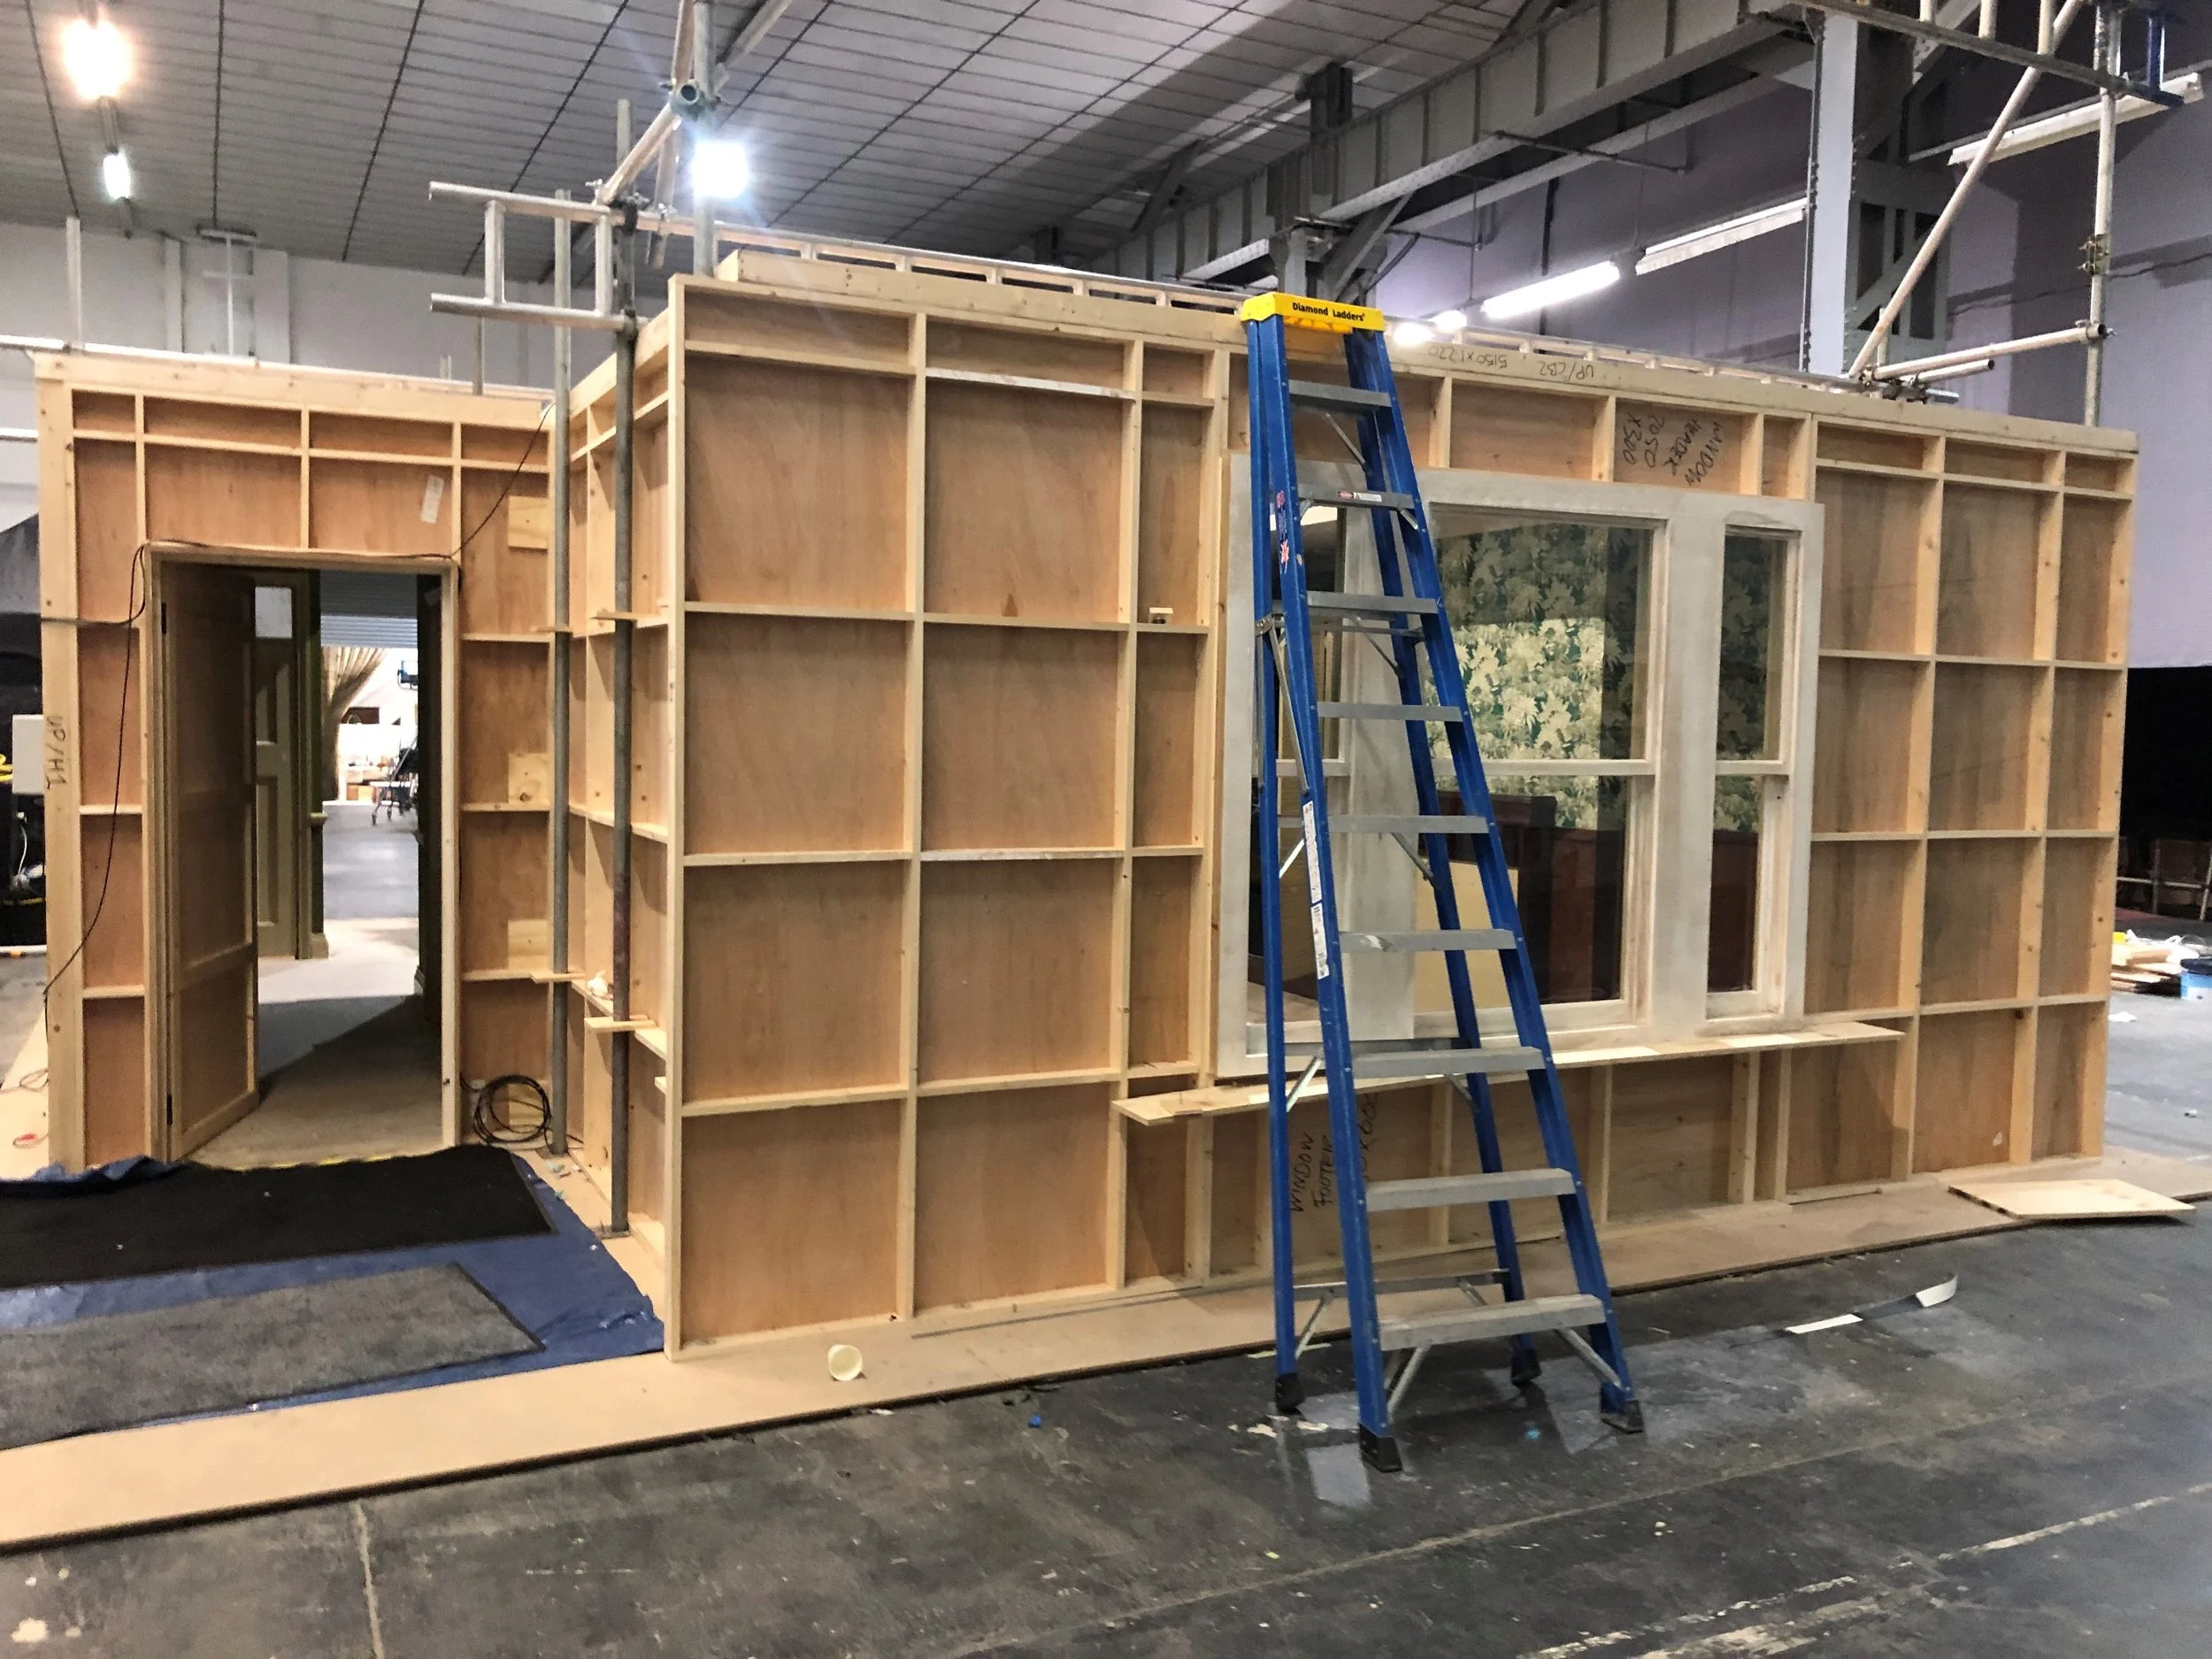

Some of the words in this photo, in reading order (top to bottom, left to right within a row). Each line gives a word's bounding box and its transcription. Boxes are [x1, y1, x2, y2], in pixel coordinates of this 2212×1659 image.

[1292, 302, 1329, 316] Diamond
[1333, 309, 1364, 321] Ladders
[1663, 417, 1702, 477] HEADER
[1684, 420, 1724, 487] WINDOW
[1289, 1131, 1314, 1213] WINDOW
